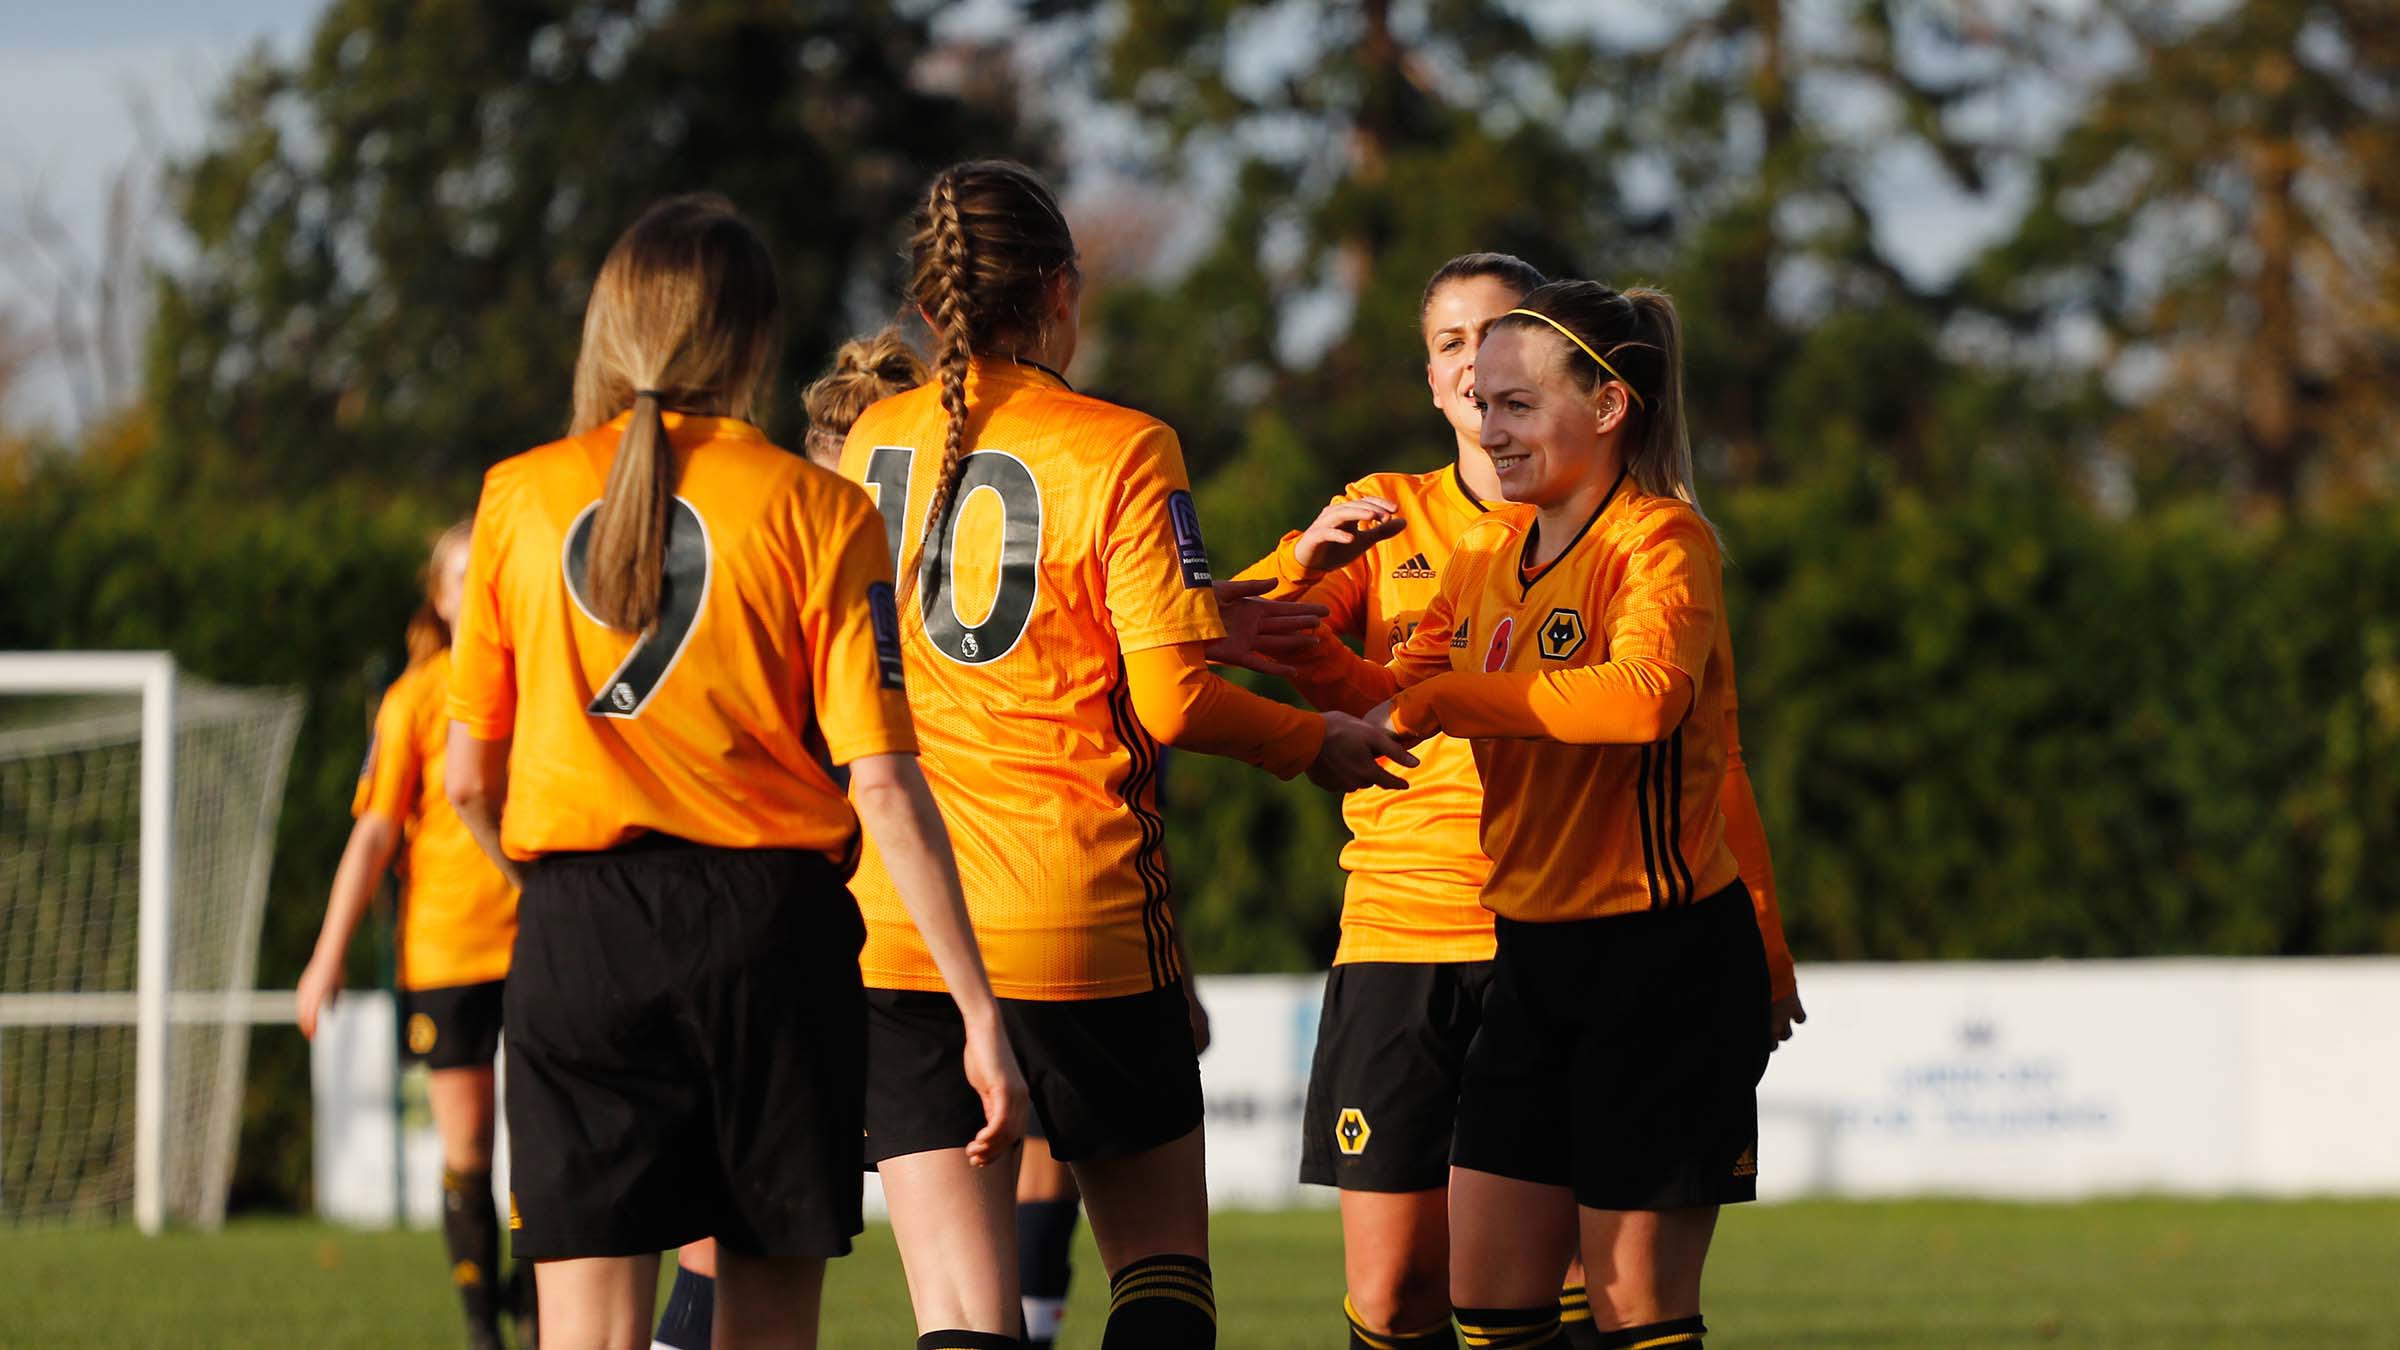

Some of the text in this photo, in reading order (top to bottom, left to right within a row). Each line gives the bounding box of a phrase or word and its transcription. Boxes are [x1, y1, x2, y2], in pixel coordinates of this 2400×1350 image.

[562, 493, 712, 719] 9
[864, 446, 1042, 666] 10
[1391, 568, 1436, 578] adidas
